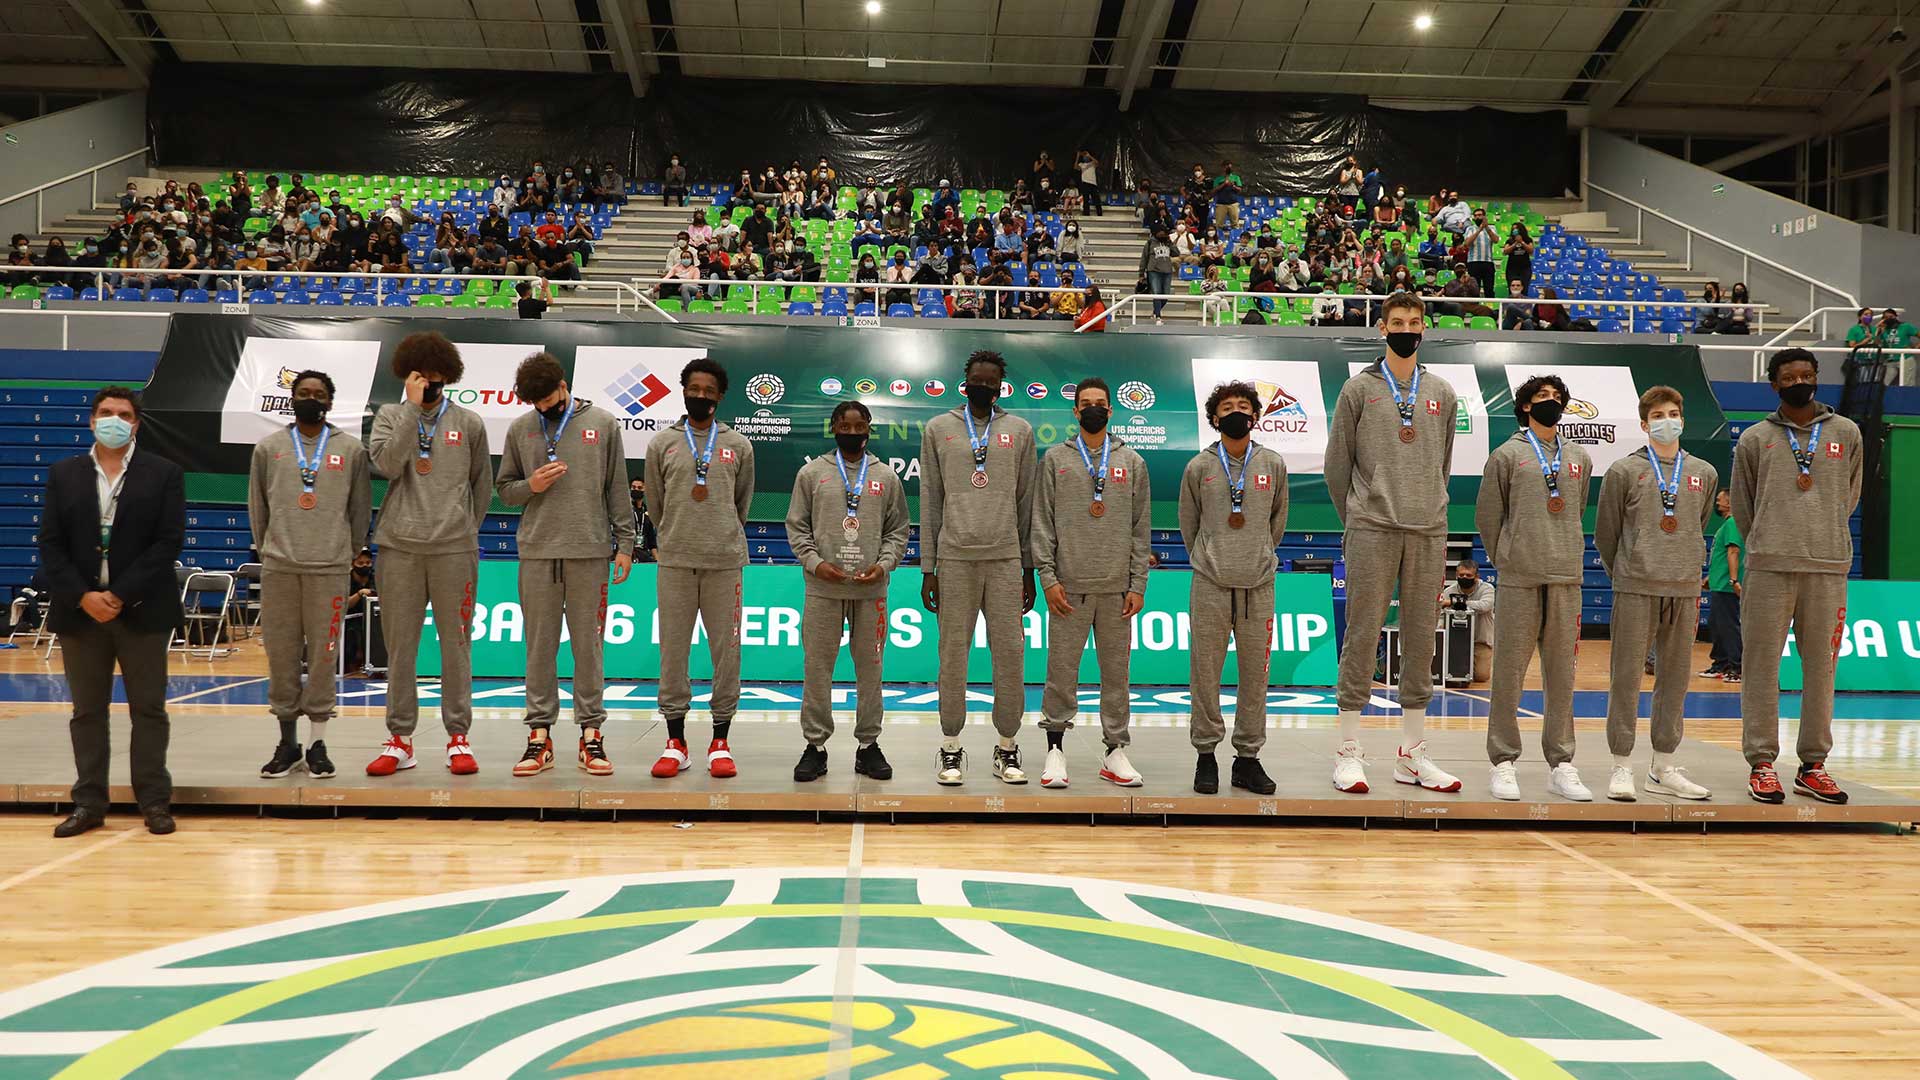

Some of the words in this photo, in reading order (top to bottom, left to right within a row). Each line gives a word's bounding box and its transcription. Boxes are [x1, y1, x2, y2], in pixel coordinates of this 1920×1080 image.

[6, 394, 11, 402] 5
[44, 395, 49, 403] 6
[35, 414, 40, 422] 6
[75, 414, 80, 422] 7
[751, 417, 791, 425] AMERICAS
[734, 424, 792, 434] CHAMPIONSHIP
[1111, 425, 1126, 434] U16
[1127, 425, 1166, 435] AMERICAS
[1252, 420, 1308, 433] ACRUZ
[34, 434, 40, 442] 6
[35, 454, 41, 462] 6
[34, 474, 40, 482] 6
[33, 494, 39, 502] 6
[33, 515, 38, 523] 6
[188, 517, 198, 525] 10
[498, 521, 507, 529] 15
[32, 535, 37, 543] 6
[1161, 532, 1169, 540] 33
[1304, 534, 1313, 542] 37
[187, 537, 197, 545] 10
[757, 545, 767, 553] 22
[186, 557, 196, 565] 10
[875, 597, 885, 640] CAN
